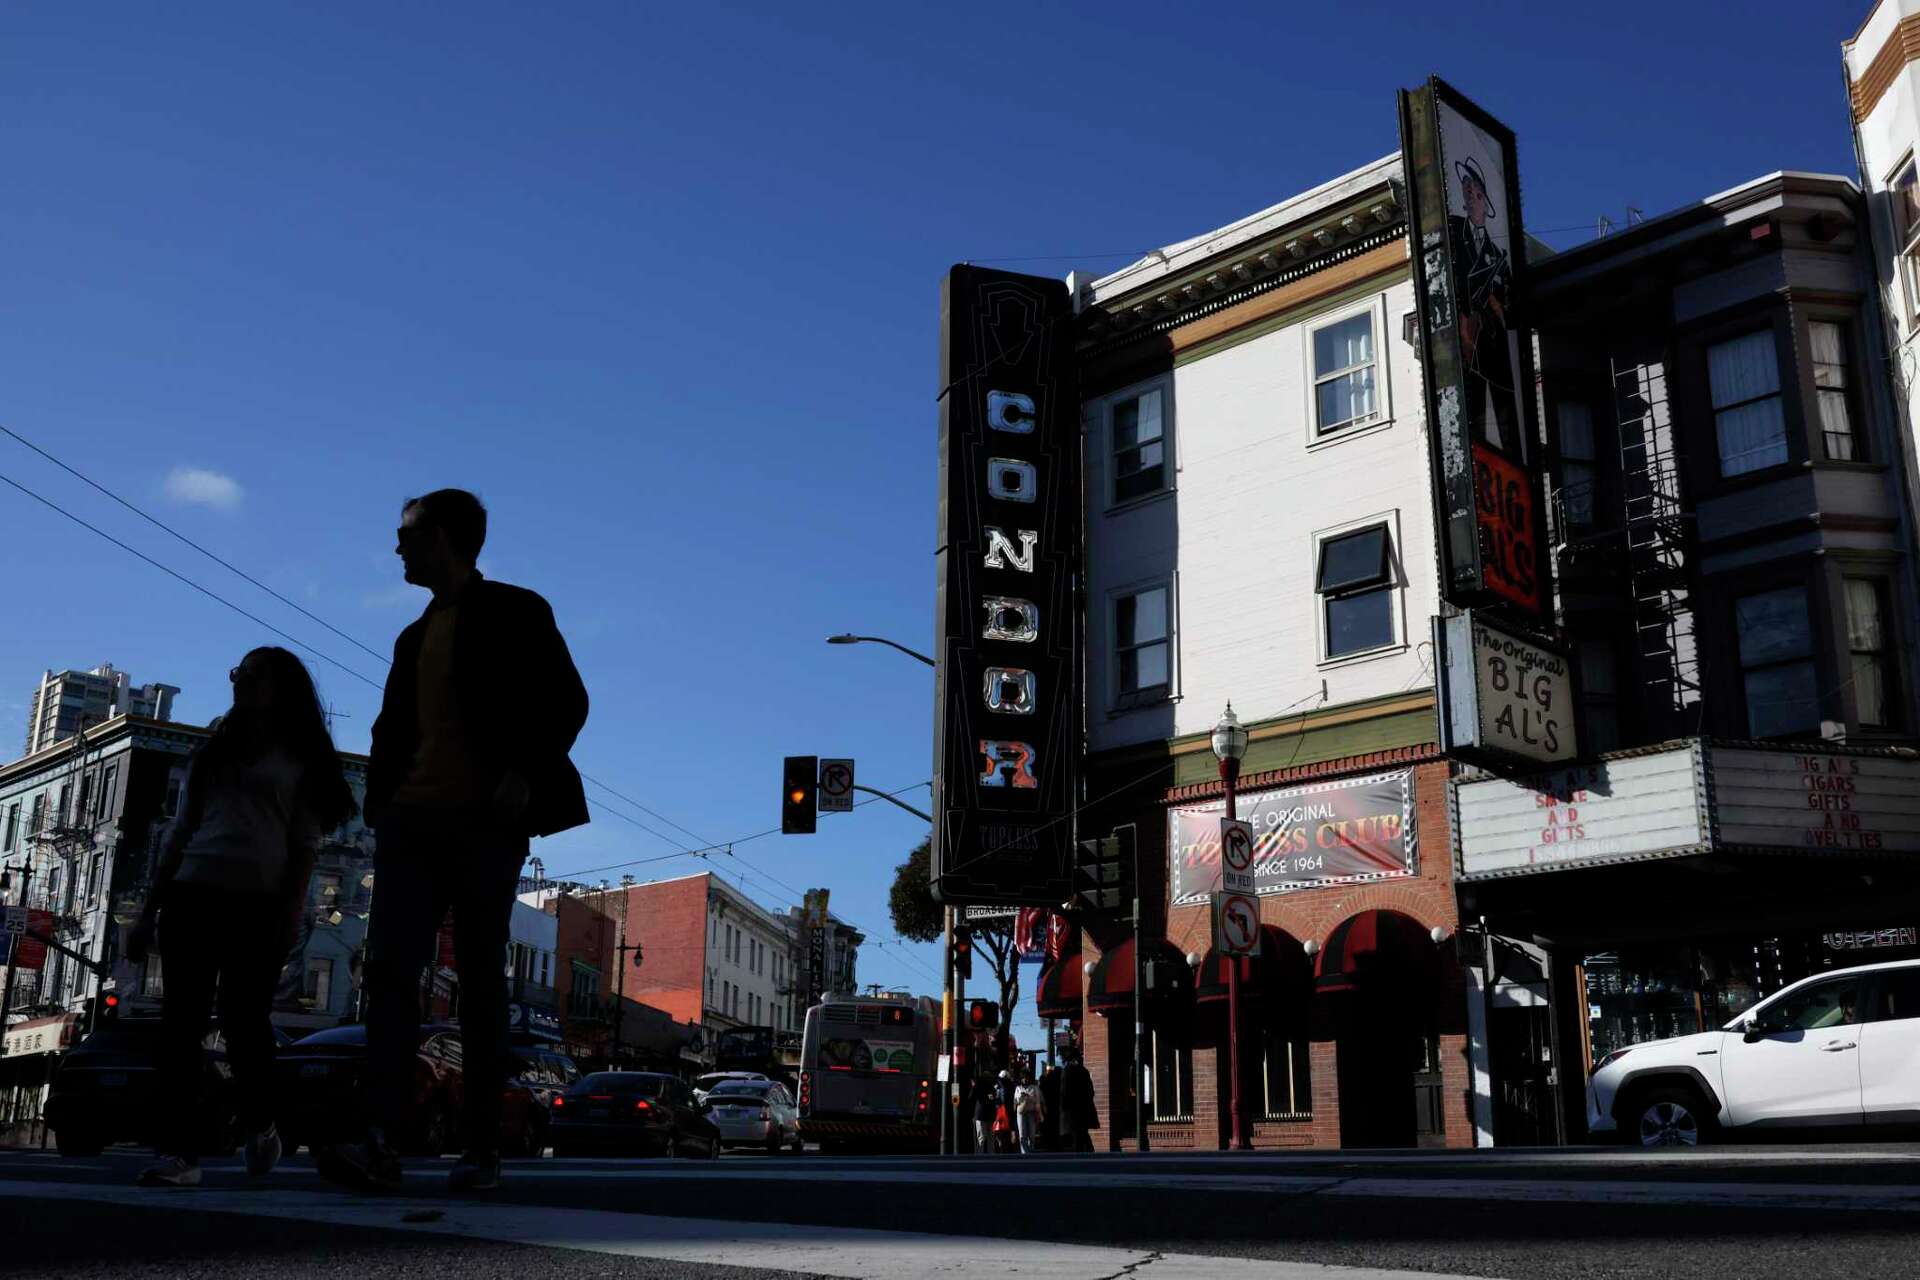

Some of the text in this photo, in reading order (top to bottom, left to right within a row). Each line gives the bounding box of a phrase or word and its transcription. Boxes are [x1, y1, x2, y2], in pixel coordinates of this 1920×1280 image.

[978, 388, 1041, 791] CONDOR
[1473, 625, 1564, 677] The Original
[1488, 656, 1552, 711] BIG
[1495, 704, 1559, 752] AL'S
[1266, 802, 1336, 824] ORIGINAL
[1808, 793, 1850, 811] GIFTS
[1316, 814, 1403, 849] CLUB
[1253, 855, 1324, 878] SINCE 1964
[6, 919, 25, 932] 25
